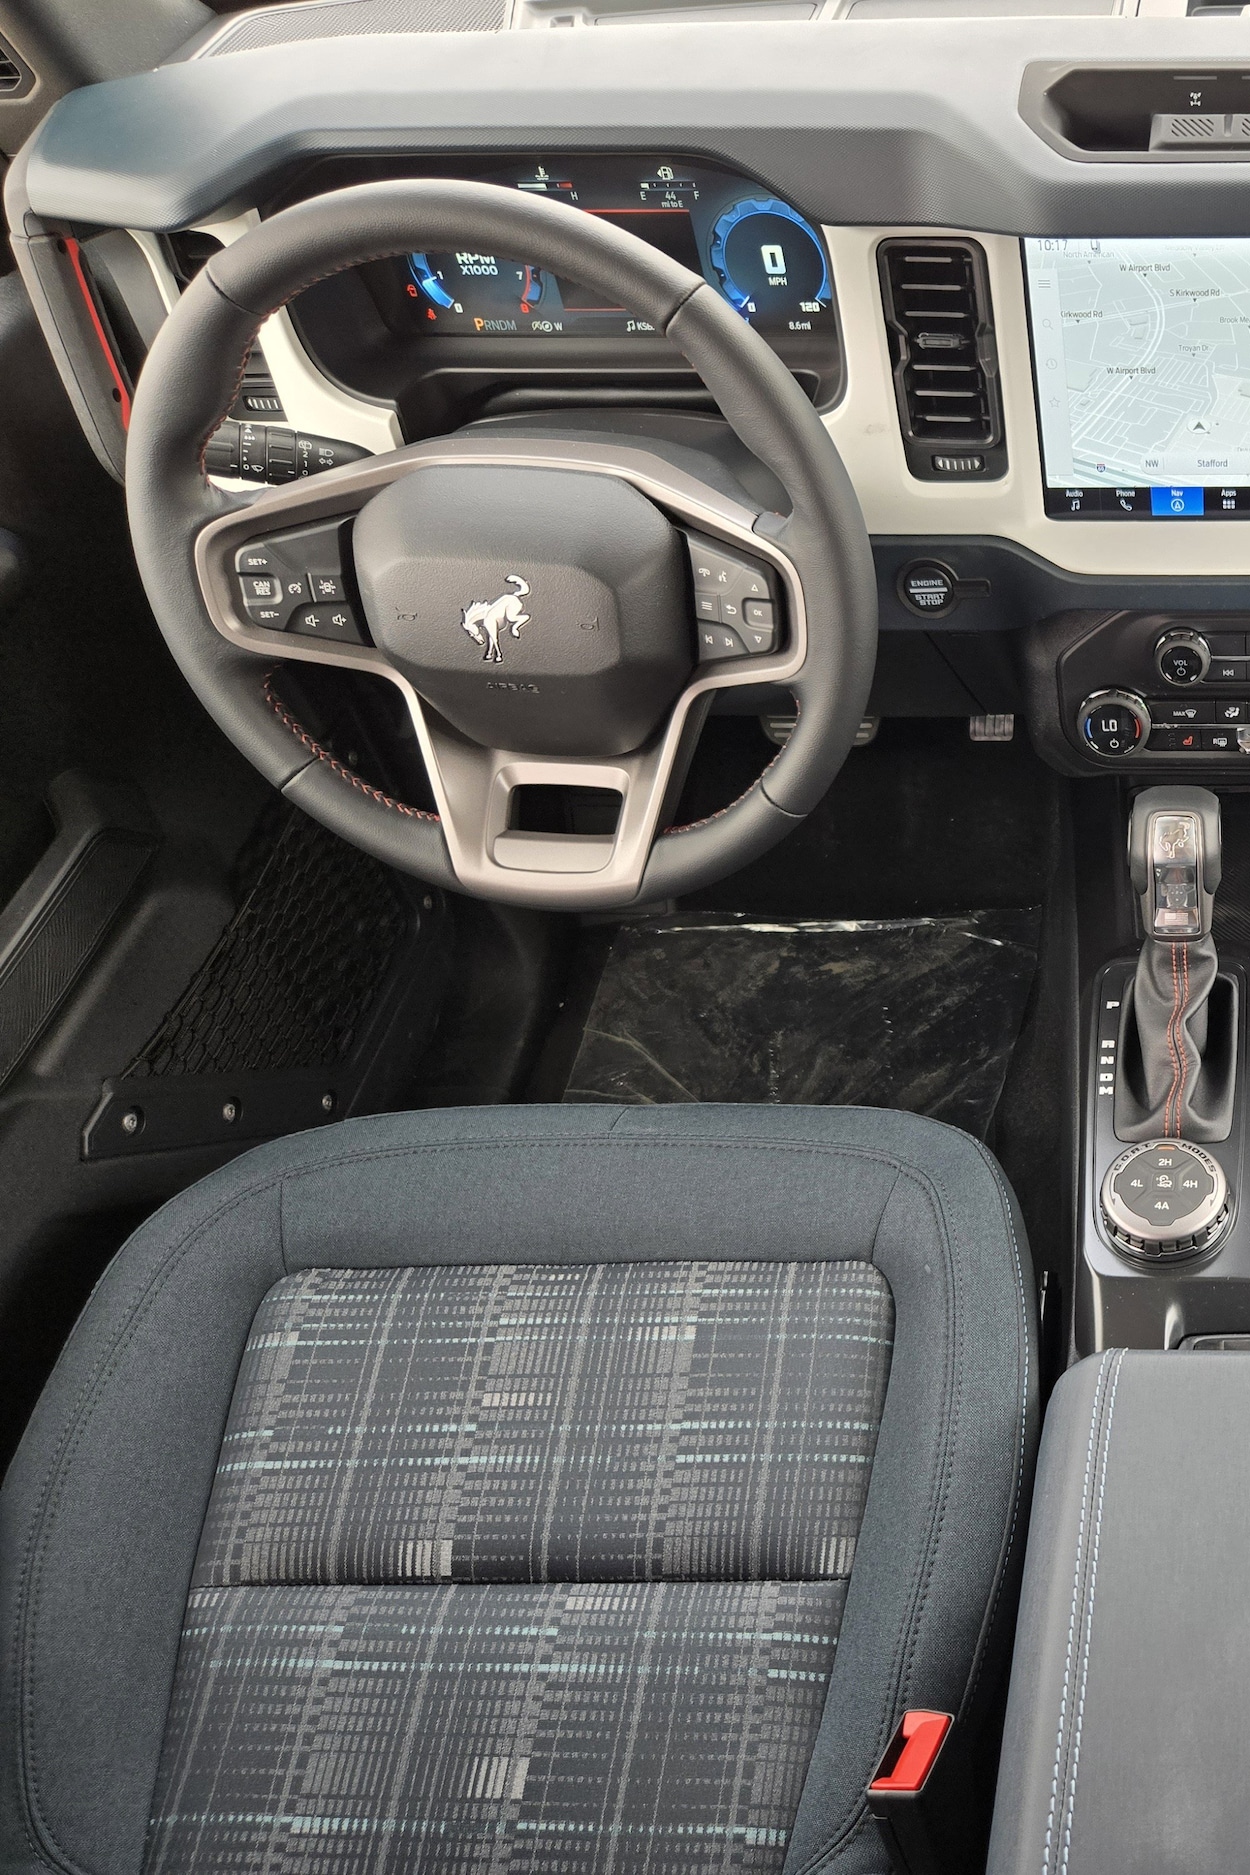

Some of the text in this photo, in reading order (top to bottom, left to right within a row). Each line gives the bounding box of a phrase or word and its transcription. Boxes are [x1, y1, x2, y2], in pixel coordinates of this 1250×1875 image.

[571, 192, 578, 200] H
[640, 192, 646, 200] E
[665, 192, 676, 200] 44
[694, 191, 700, 200] F
[1038, 239, 1068, 251] 10:17
[455, 253, 496, 264] RPM
[761, 245, 786, 274] 0
[460, 265, 498, 275] X1000
[1127, 264, 1152, 272] Airport
[516, 271, 523, 280] 7
[768, 277, 787, 286] MPH
[1170, 289, 1220, 297] S Kirkwood Rd
[747, 302, 756, 312] 0
[799, 302, 820, 312] 120
[637, 322, 655, 331] KSB
[1114, 367, 1138, 375] Airport
[1197, 459, 1228, 467] Stafford
[1066, 489, 1083, 497] Audio
[1116, 489, 1135, 497] Phone
[1171, 489, 1183, 497] Nav
[1221, 489, 1236, 498] Apps
[911, 578, 944, 587] ENGINE
[256, 588, 271, 596] RES
[915, 593, 945, 601] START
[1102, 719, 1118, 732] LO
[1106, 1001, 1120, 1009] P
[1101, 1040, 1115, 1048] R
[1100, 1056, 1114, 1065] N
[1100, 1073, 1114, 1082] D
[1099, 1086, 1114, 1095] M
[1182, 1143, 1216, 1172] MODES
[1130, 1179, 1144, 1187] 4L
[1183, 1180, 1198, 1188] 4H
[1154, 1201, 1169, 1210] 4A
